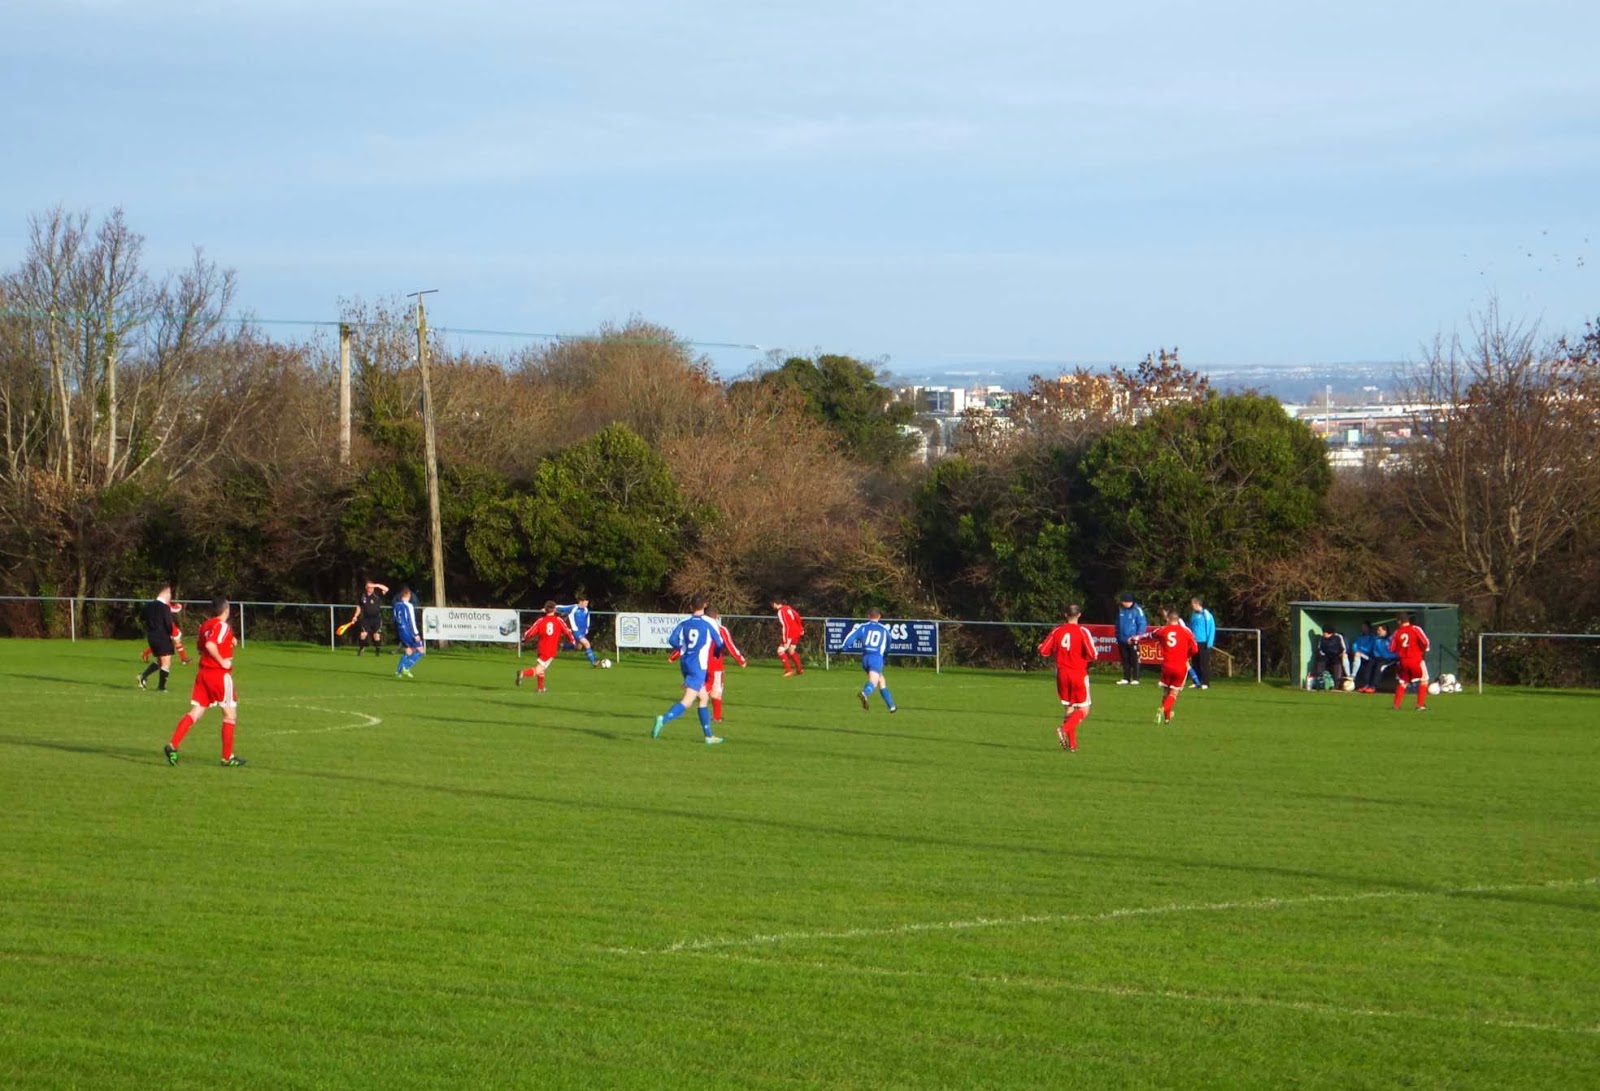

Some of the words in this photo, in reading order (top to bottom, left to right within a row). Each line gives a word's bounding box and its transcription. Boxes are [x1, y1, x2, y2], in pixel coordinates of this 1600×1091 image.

[546, 622, 554, 636] 8
[688, 629, 700, 648] 9
[865, 630, 881, 647] 10
[1061, 633, 1071, 651] 4
[1166, 631, 1177, 648] 5
[1400, 633, 1409, 647] 2
